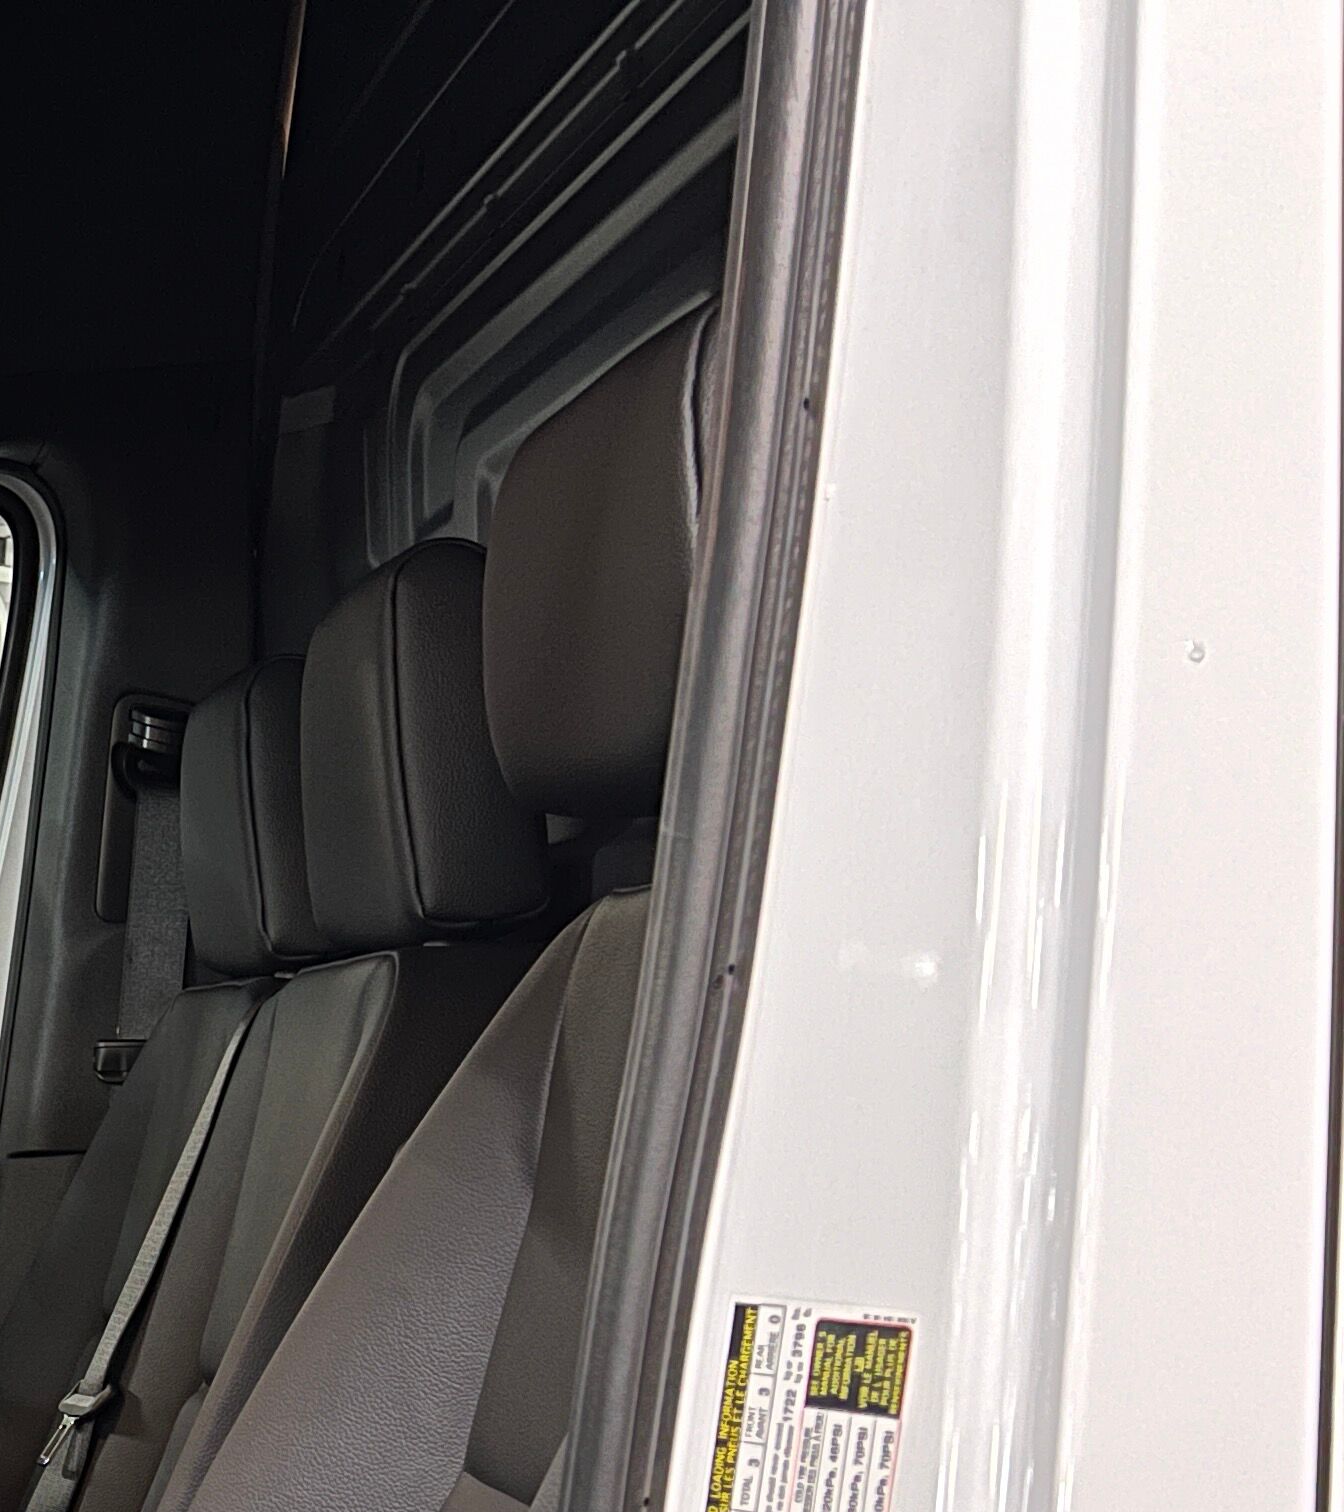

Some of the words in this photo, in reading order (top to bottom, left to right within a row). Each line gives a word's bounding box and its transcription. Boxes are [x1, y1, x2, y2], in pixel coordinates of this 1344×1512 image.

[768, 1314, 780, 1324] 0
[735, 1308, 757, 1386] CHARGEMENT
[755, 1344, 765, 1369] REAR
[717, 1359, 739, 1439] INFORMATION
[734, 1390, 745, 1403] LE
[758, 1387, 770, 1396] 3
[782, 1388, 796, 1422] 1722
[731, 1409, 742, 1422] ET
[744, 1406, 755, 1437] FRONT
[755, 1406, 767, 1439] AVANT
[725, 1425, 740, 1463] PNEUS
[709, 1446, 726, 1498] LOADING
[722, 1466, 734, 1488] LES
[739, 1474, 753, 1506] TOTAL
[747, 1457, 760, 1468] 3
[718, 1491, 731, 1512] SUR
